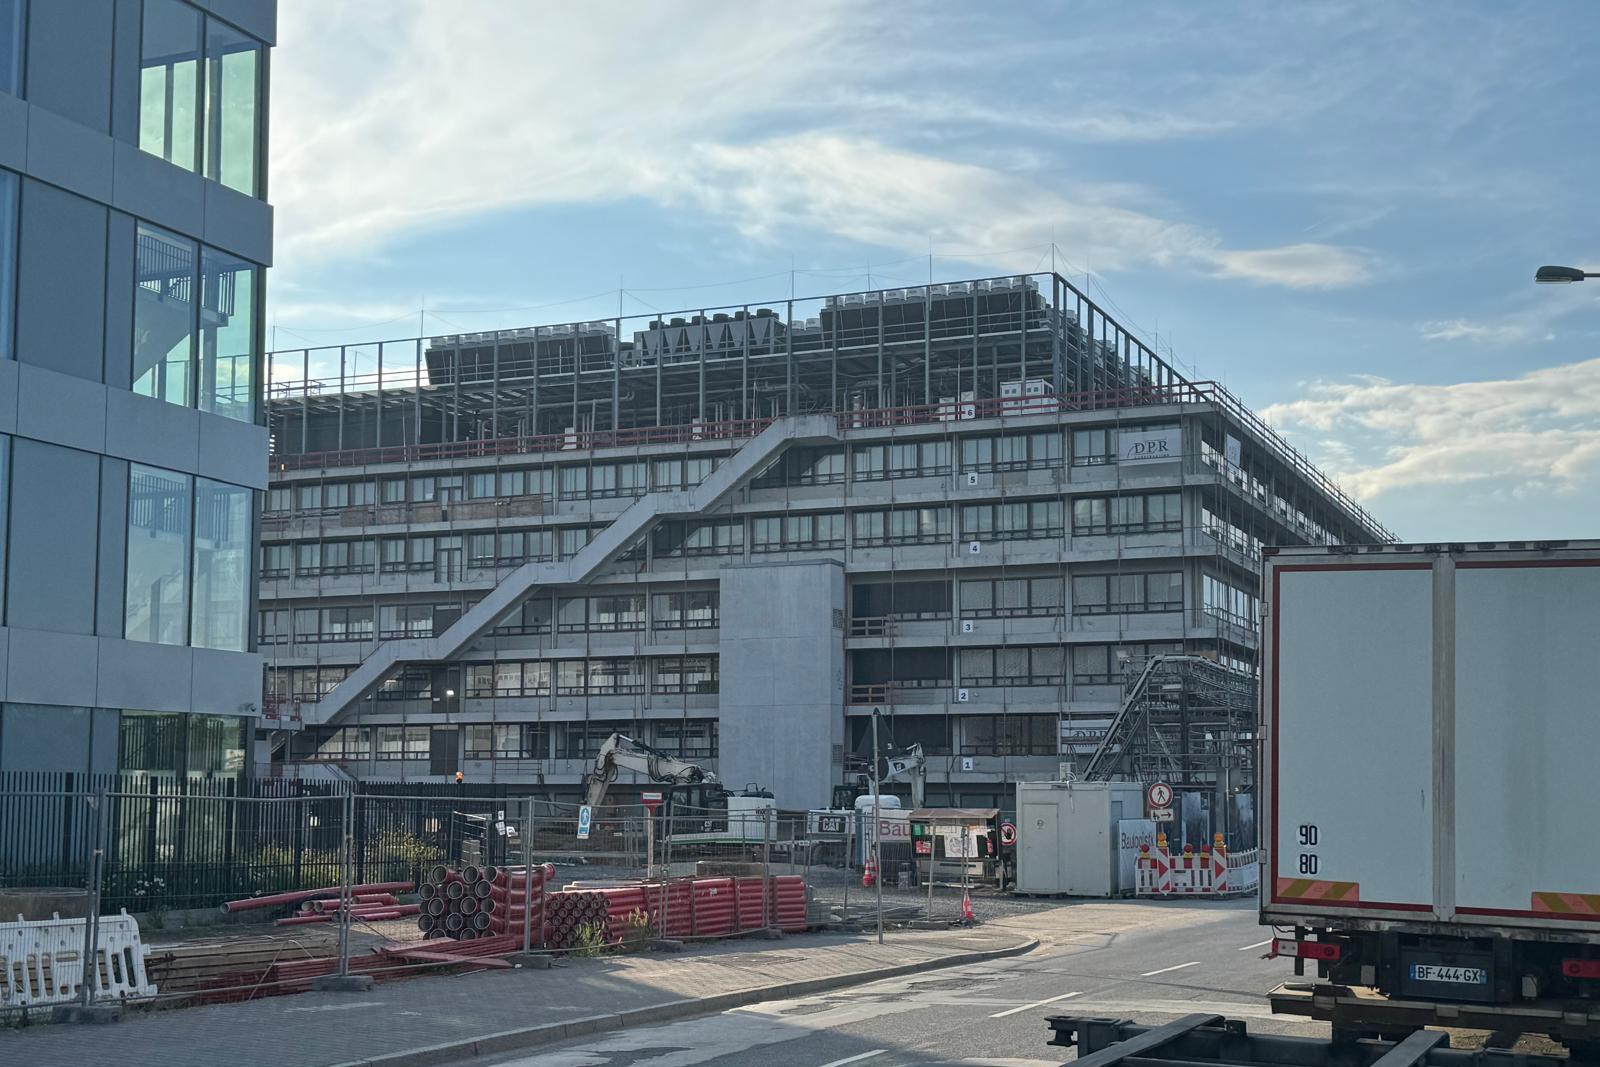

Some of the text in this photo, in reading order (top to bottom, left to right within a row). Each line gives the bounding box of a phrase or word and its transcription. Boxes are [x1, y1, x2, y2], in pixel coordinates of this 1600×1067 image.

[967, 409, 973, 417] 6
[1134, 440, 1169, 454] DPR
[970, 475, 976, 484] 5
[972, 545, 978, 553] 4
[965, 623, 971, 632] 3
[960, 692, 967, 700] 2
[964, 761, 971, 769] 1
[822, 817, 841, 832] CAT
[1299, 825, 1318, 846] 90
[1299, 853, 1318, 875] 80
[1417, 965, 1479, 982] BF-444-GX
